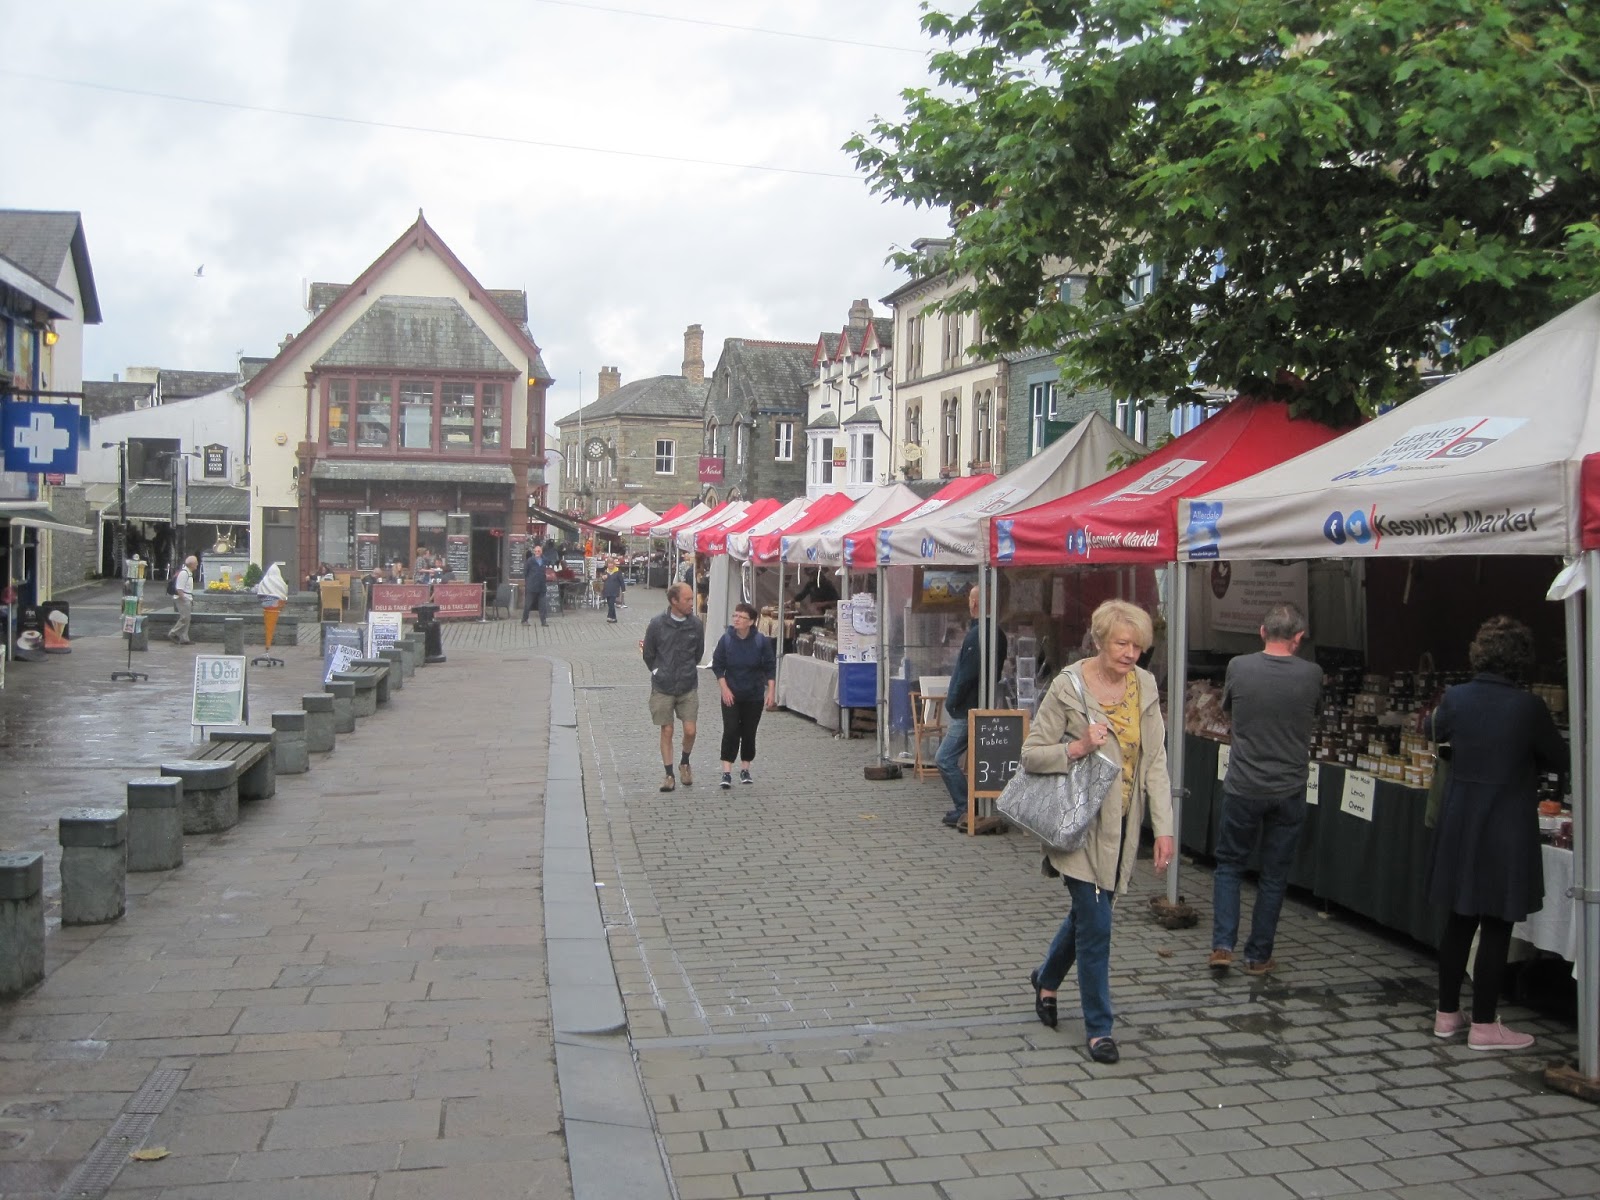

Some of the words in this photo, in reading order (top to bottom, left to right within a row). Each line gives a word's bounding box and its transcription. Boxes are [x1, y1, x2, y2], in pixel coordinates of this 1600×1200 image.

[1393, 427, 1465, 447] GERAUD
[700, 465, 722, 475] Ness
[1374, 512, 1457, 537] Keswick
[1462, 507, 1538, 533] Market
[1122, 529, 1160, 548] Market
[224, 668, 239, 679] off
[981, 724, 1010, 733] Fudge
[980, 737, 1009, 746] Tablet
[1351, 788, 1366, 799] Lemon
[1348, 800, 1365, 813] Cheese
